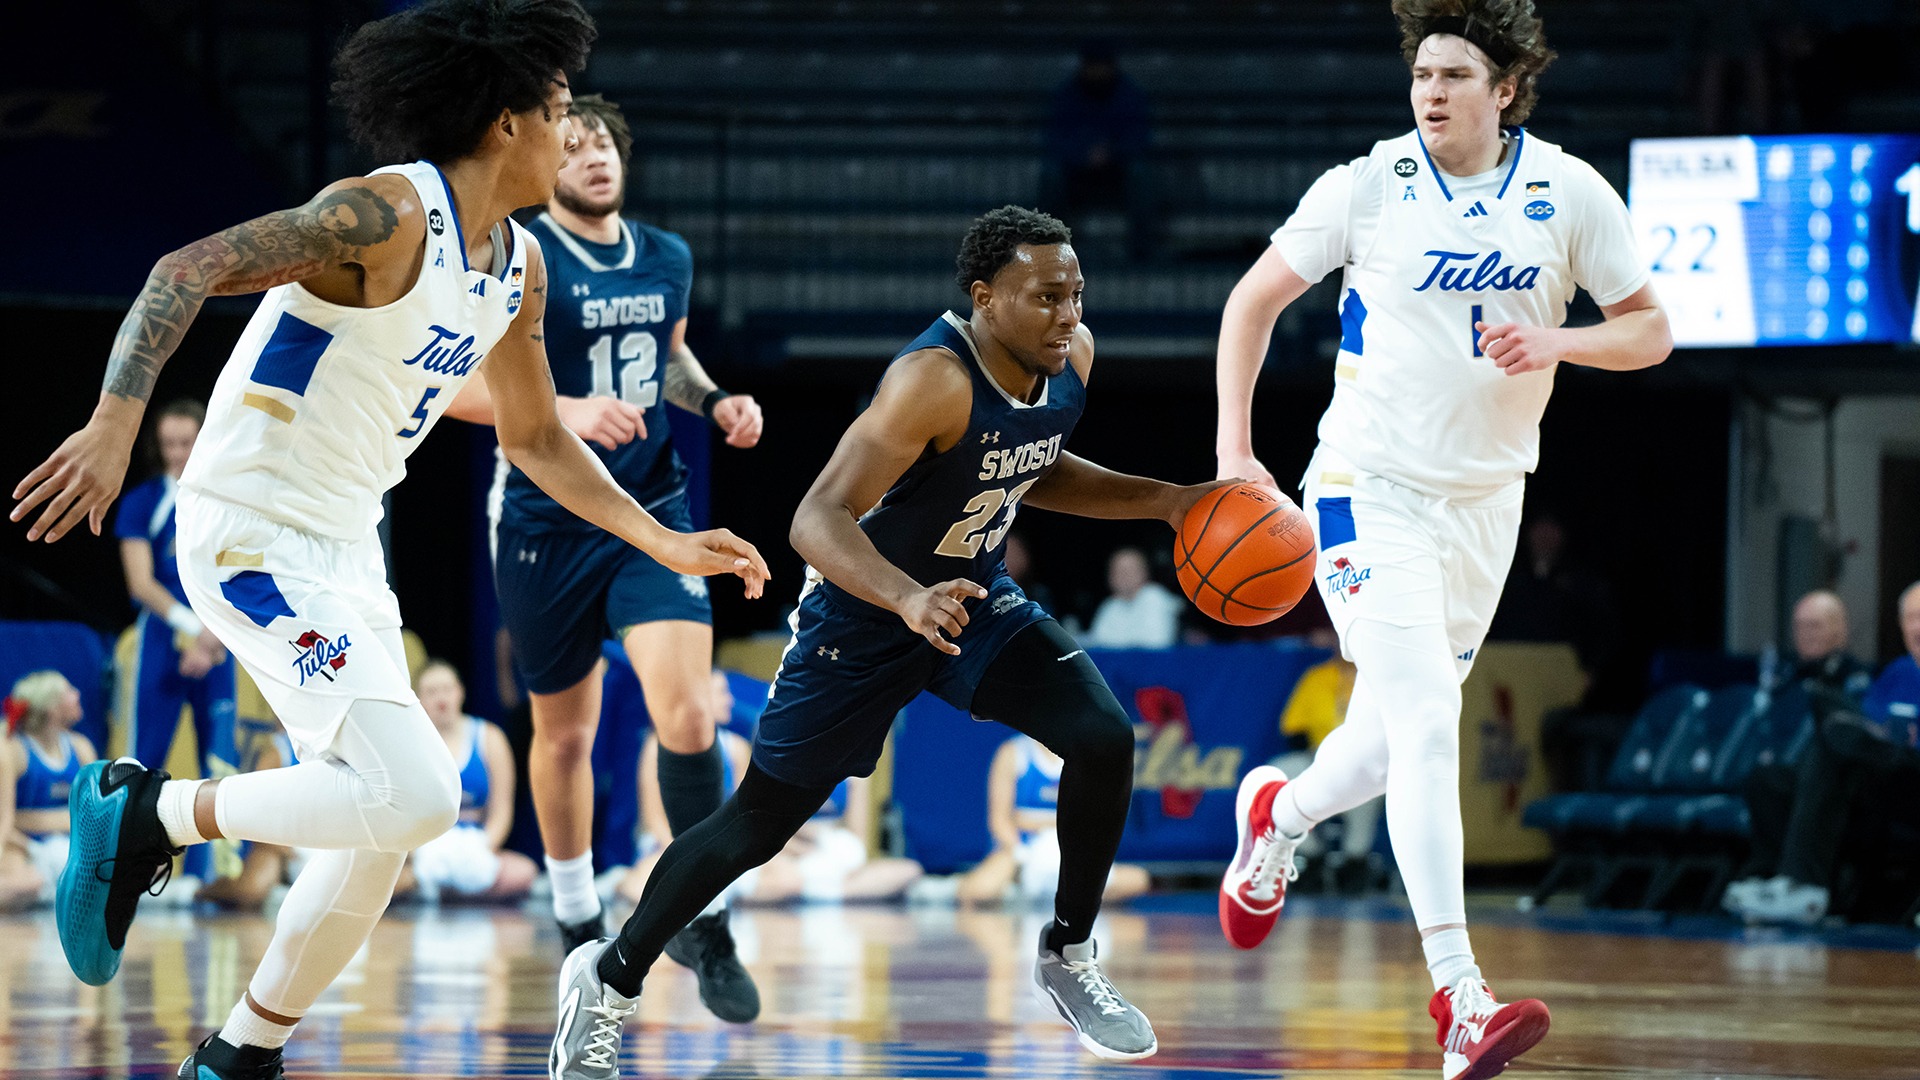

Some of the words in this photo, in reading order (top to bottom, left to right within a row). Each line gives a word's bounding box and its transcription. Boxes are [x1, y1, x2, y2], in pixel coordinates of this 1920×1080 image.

[1397, 162, 1415, 174] 32
[431, 215, 444, 230] 32
[1526, 206, 1553, 215] DOC
[1412, 250, 1541, 292] Tulsa
[1649, 222, 1718, 274] 22
[582, 294, 666, 329] SWOSU
[588, 331, 659, 408] 12
[395, 385, 442, 439] 5
[978, 433, 1063, 481] SWOSU
[933, 476, 1040, 560] 23
[1326, 567, 1372, 598] Tulsa
[292, 633, 352, 687] Tulsa
[1132, 719, 1243, 790] lsa
